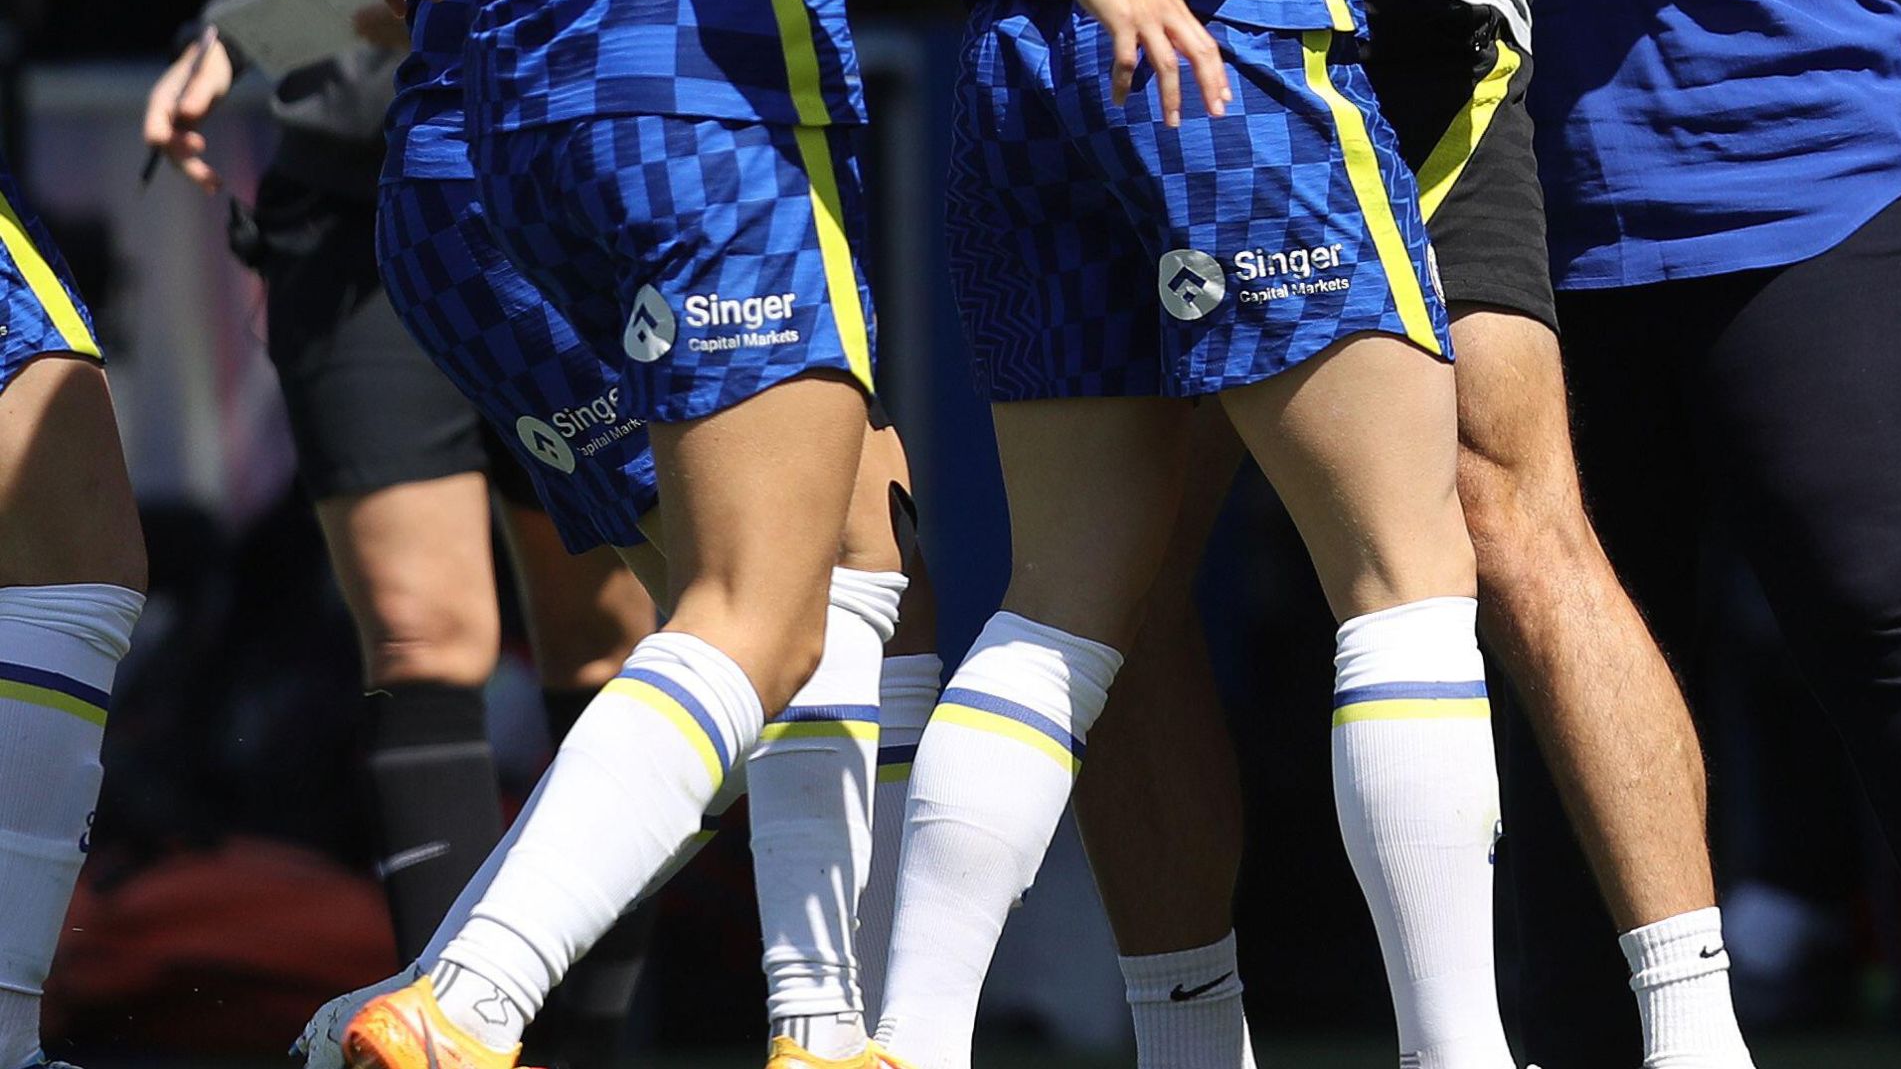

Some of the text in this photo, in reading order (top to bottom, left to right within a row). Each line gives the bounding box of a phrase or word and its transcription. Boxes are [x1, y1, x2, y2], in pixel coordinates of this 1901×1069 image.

[1234, 243, 1343, 281] Singer
[1240, 278, 1350, 305] Capital Markets
[686, 294, 796, 330] Singer
[688, 329, 799, 353] Capital Markets
[552, 387, 619, 438] Singe
[576, 432, 612, 456] apital
